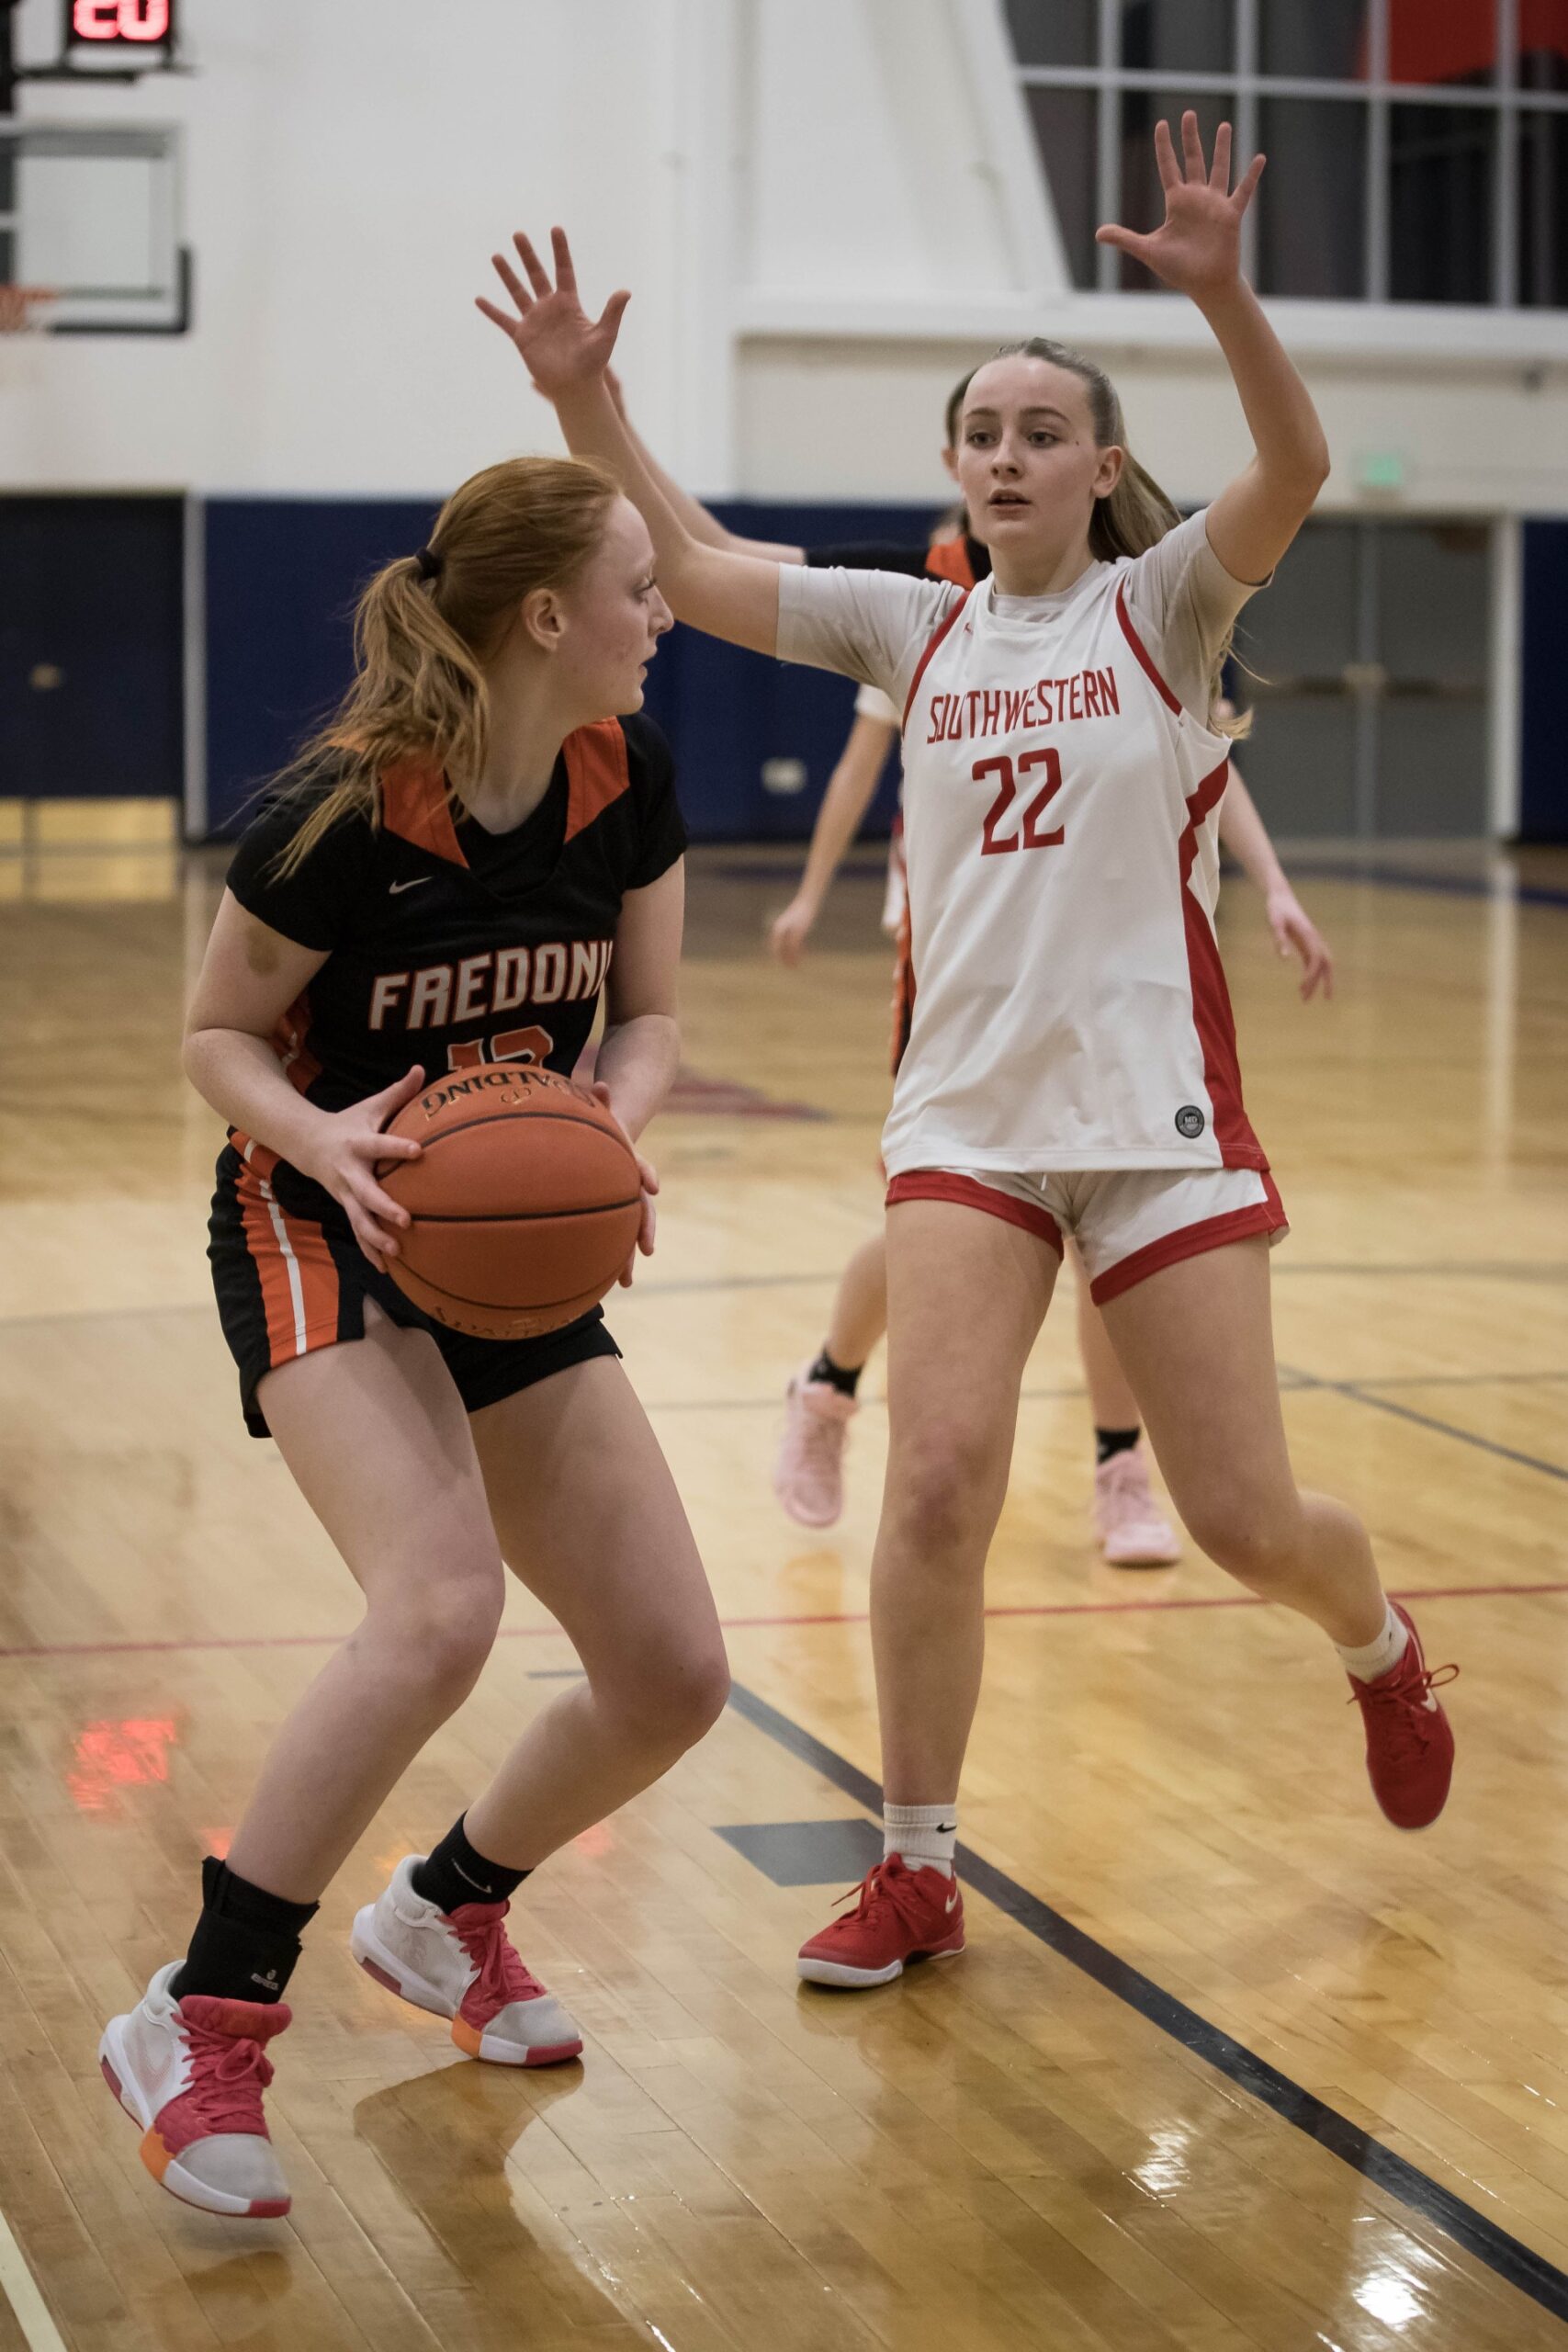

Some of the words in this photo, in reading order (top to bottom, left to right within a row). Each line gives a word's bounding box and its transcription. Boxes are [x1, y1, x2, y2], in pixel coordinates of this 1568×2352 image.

[926, 666, 1120, 744] SOUTHWESTERN
[972, 748, 1065, 855] 22
[368, 940, 614, 1030] FREDONI
